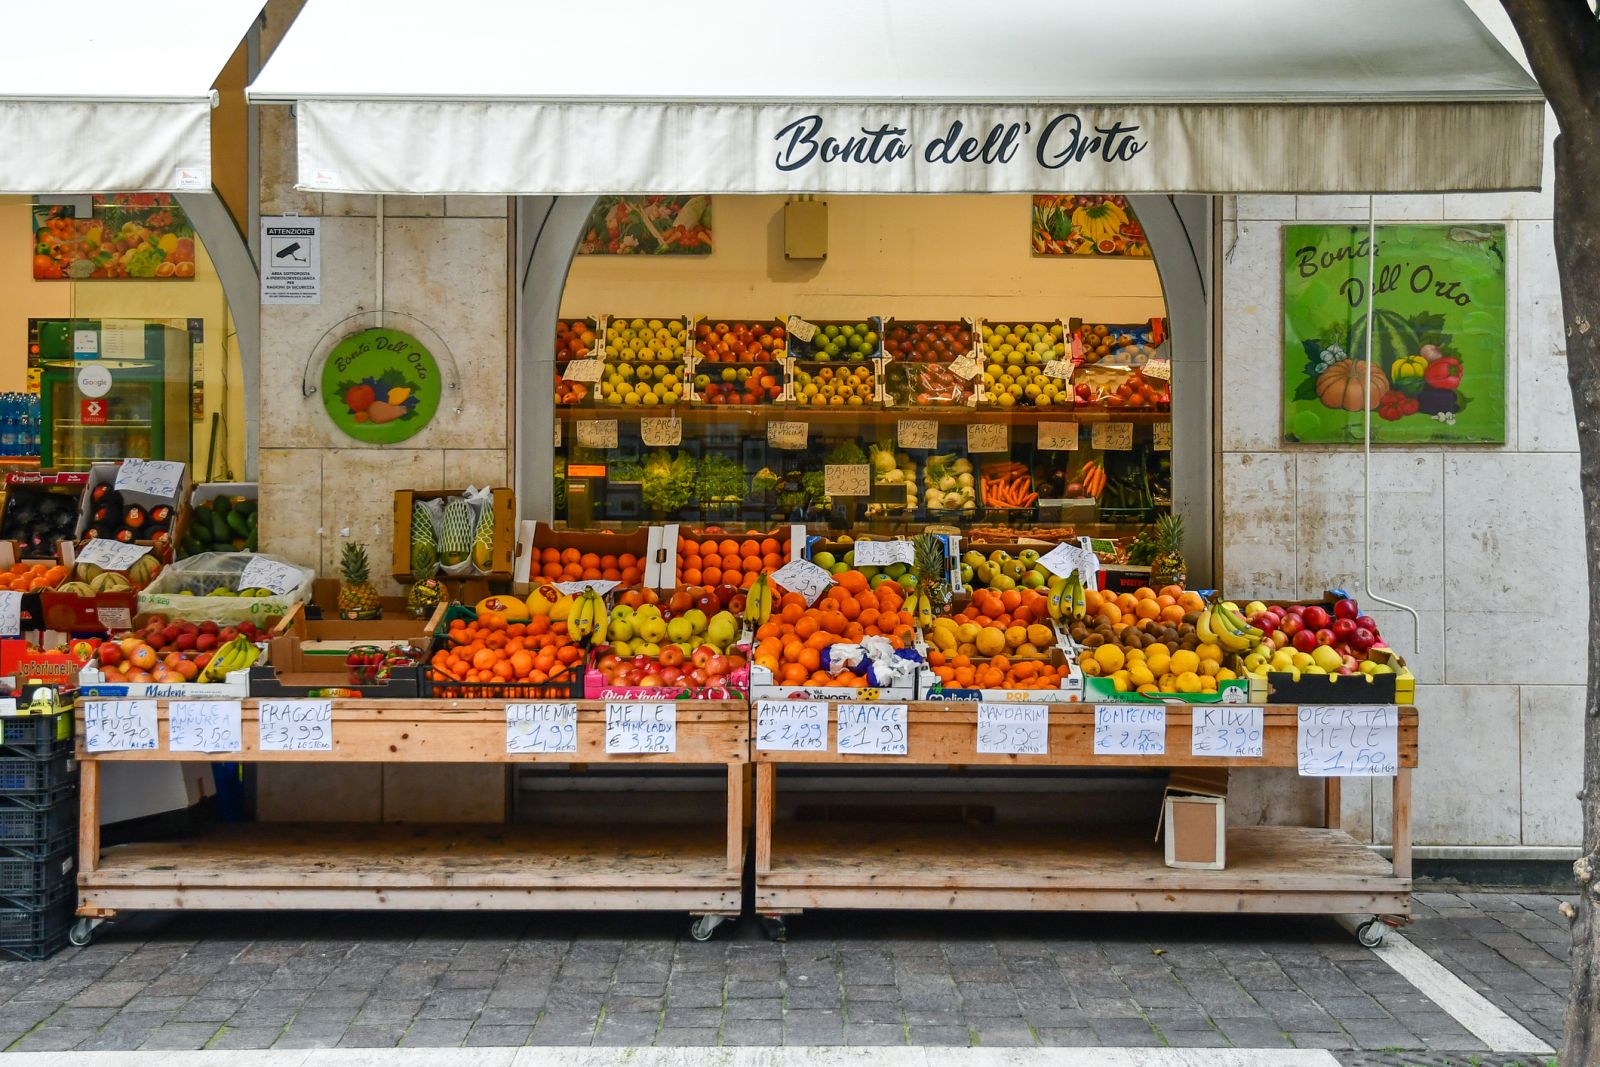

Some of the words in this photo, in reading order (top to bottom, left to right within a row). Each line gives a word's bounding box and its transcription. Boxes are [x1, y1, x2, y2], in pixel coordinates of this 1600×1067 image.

[82, 378, 107, 388] Google
[899, 421, 936, 431] FINOCCHI
[1050, 437, 1074, 449] 3,50
[826, 466, 868, 476] BANANE
[838, 478, 867, 493] 2,90
[31, 661, 79, 676] Fortunella
[145, 685, 186, 697] Marlene
[88, 702, 138, 719] MELE
[176, 703, 219, 717] MELE
[261, 703, 331, 723] FRAGOLE
[610, 705, 664, 722] MELE
[760, 703, 818, 718] ANANAS
[838, 705, 901, 724] ARANCE
[1099, 707, 1163, 725] POMPELMO
[1205, 709, 1253, 726] KIWI
[1299, 707, 1388, 728] OFERTA
[101, 716, 141, 730] FUJI
[647, 723, 672, 733] LADY
[781, 723, 822, 740] 2,99
[88, 734, 99, 746] €
[193, 727, 231, 747] 3,50
[262, 731, 277, 743] €
[278, 725, 324, 746] 3,99
[506, 736, 521, 749] €
[523, 724, 574, 750] 1,99
[609, 734, 621, 747] €
[629, 733, 665, 751] 3,50
[839, 736, 851, 748] €
[853, 724, 904, 748] 1,99
[994, 724, 1041, 746] 3,90
[1216, 728, 1260, 750] 3,90
[1306, 726, 1380, 748] MELE
[1299, 758, 1319, 774] €
[1324, 748, 1386, 773] 1,50
